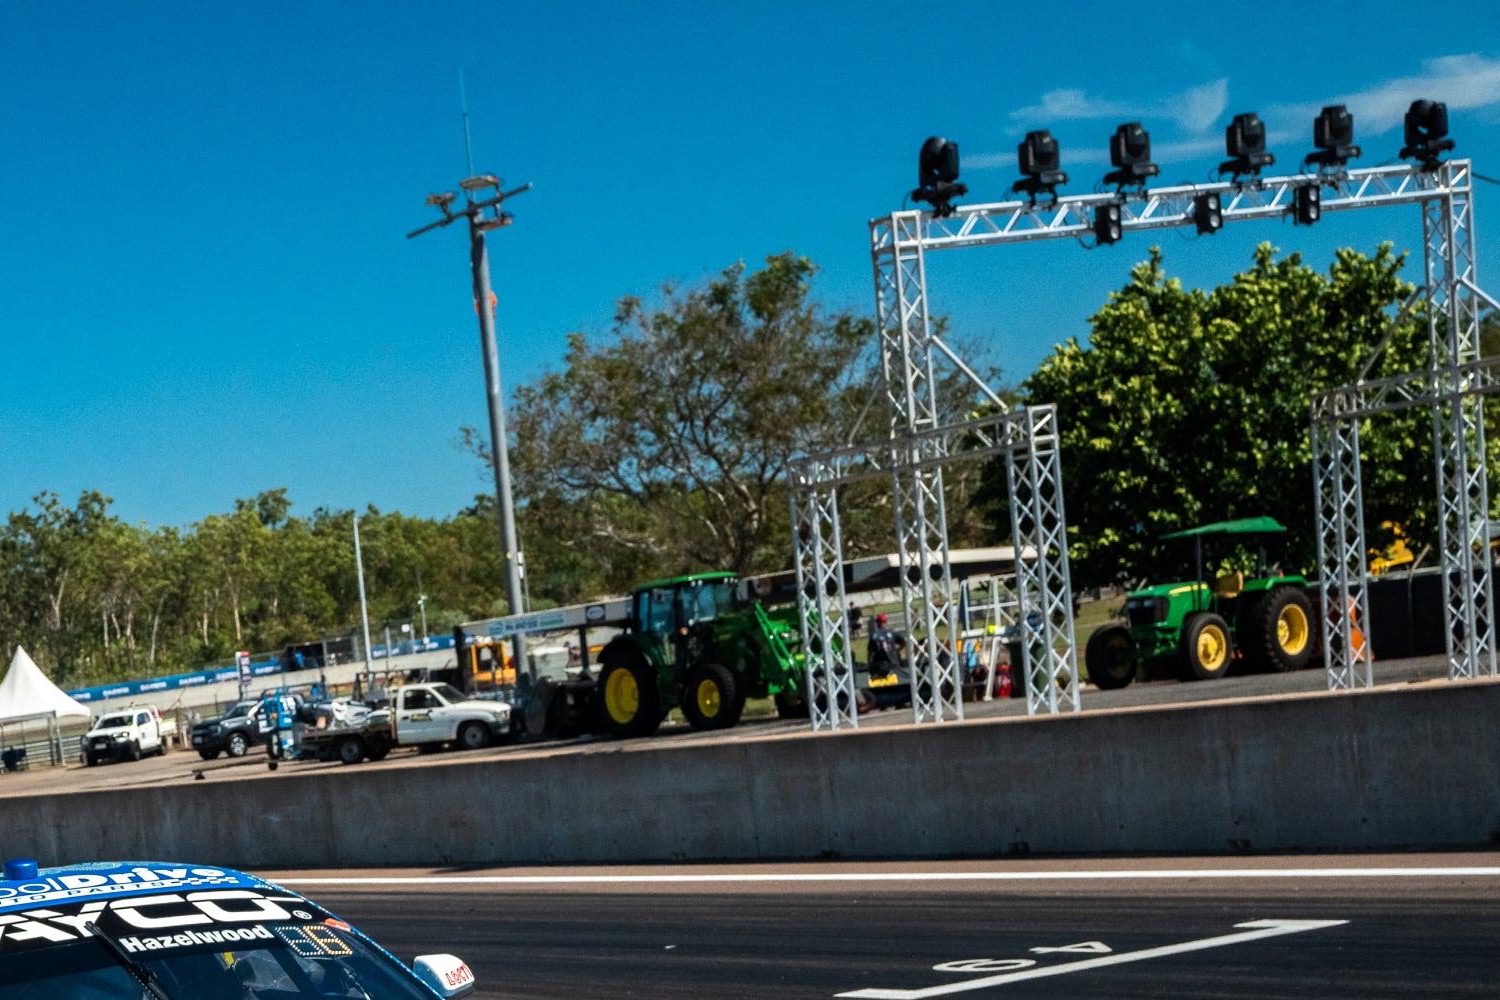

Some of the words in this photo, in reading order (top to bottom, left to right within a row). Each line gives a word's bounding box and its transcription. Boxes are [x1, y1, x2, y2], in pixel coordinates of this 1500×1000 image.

[70, 881, 167, 896] PARTS
[119, 924, 275, 953] Hazelwood
[445, 961, 473, 986] LOCTI
